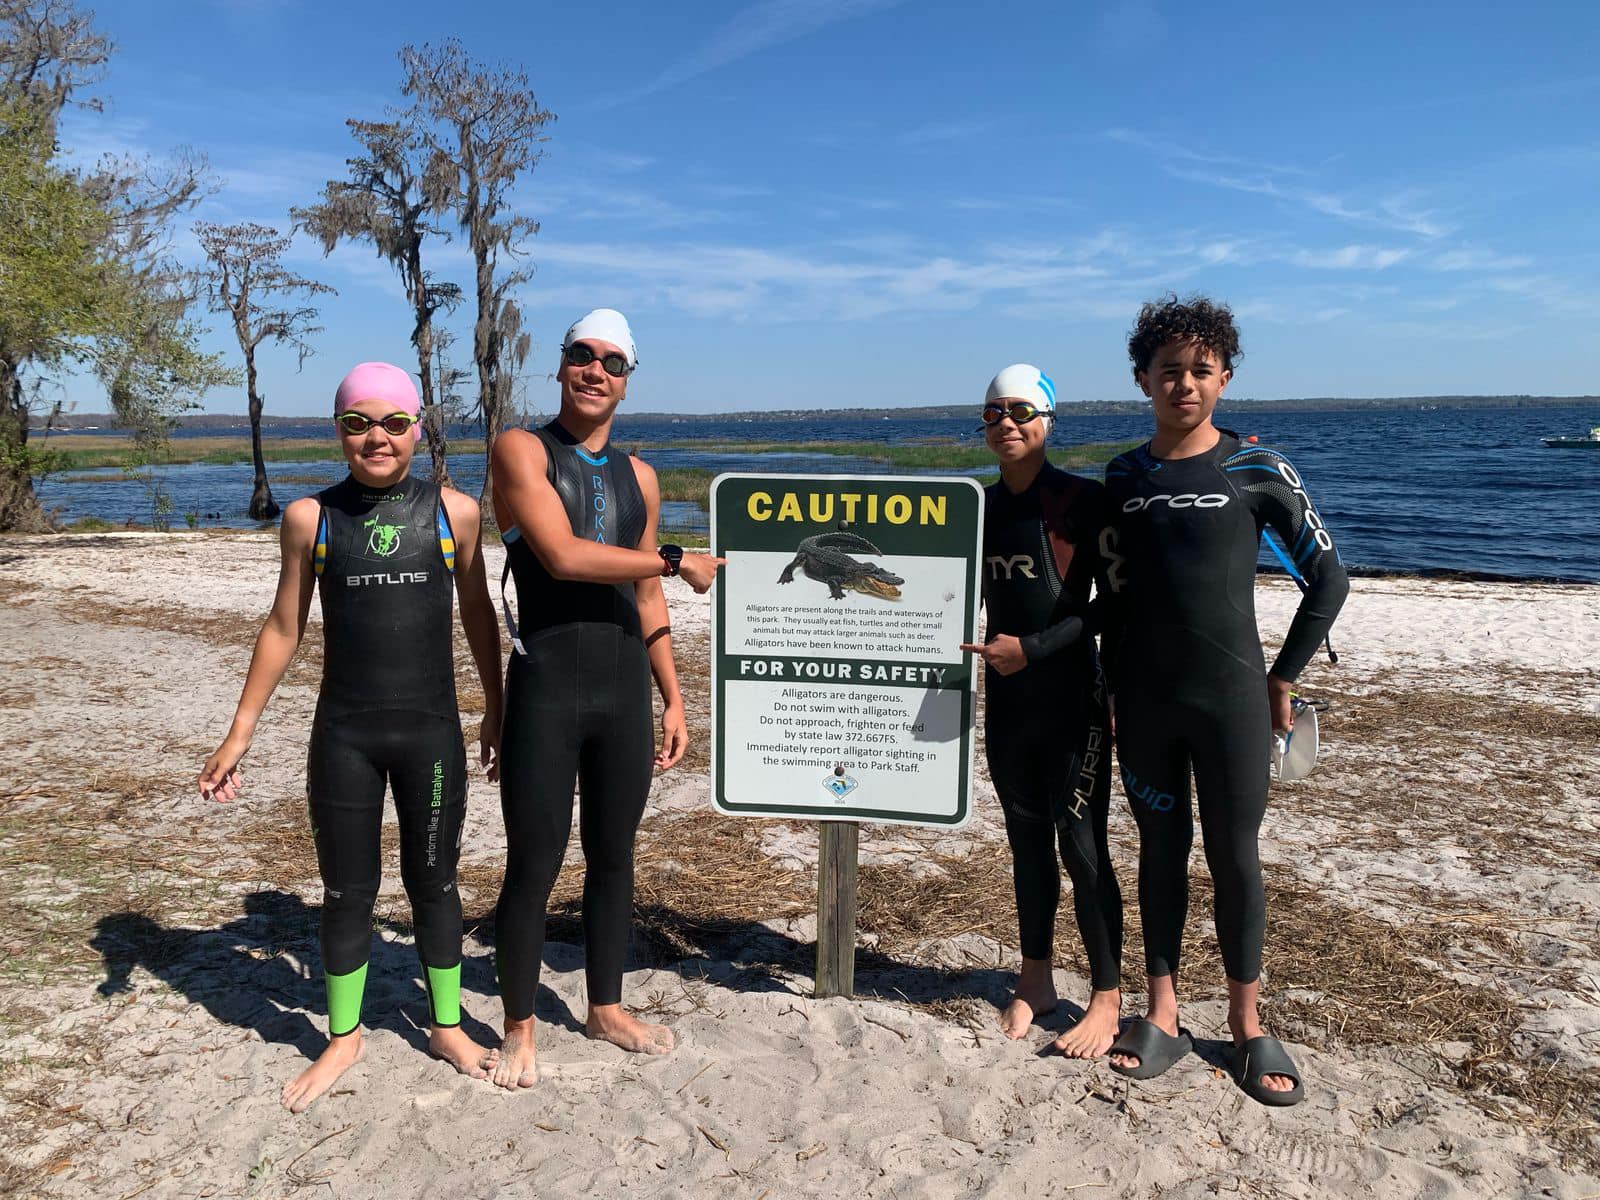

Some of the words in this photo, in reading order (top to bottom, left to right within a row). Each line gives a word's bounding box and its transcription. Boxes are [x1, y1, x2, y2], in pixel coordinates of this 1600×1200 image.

[747, 491, 947, 526] CAUTION
[1122, 493, 1230, 513] orca
[1278, 462, 1332, 550] orca
[986, 555, 1038, 579] TYR
[746, 604, 779, 613] Alligators
[823, 607, 843, 615] along
[893, 610, 933, 618] waterways
[784, 616, 801, 624] They
[803, 617, 828, 625] usually
[843, 618, 858, 627] fish,
[836, 629, 857, 638] larger
[858, 630, 887, 638] animals
[917, 632, 935, 640] deer.
[744, 638, 784, 648] Alligators
[786, 640, 807, 648] have
[809, 640, 831, 648] been
[833, 641, 863, 650] known
[865, 643, 875, 651] to
[876, 643, 904, 652] attack
[905, 644, 943, 654] humans.
[740, 660, 784, 676] FOR
[792, 661, 852, 678] YOUR
[859, 664, 946, 683] SAFETY
[781, 688, 827, 699] Alligators
[830, 691, 846, 699] are
[848, 691, 903, 703] dangerous.
[774, 702, 787, 711] Do
[790, 704, 807, 712] not
[809, 704, 835, 713] swim
[838, 705, 860, 714] with
[862, 705, 910, 717] alligators.
[760, 715, 773, 724] Do
[776, 717, 793, 726] not
[795, 718, 844, 728] approach,
[847, 719, 886, 731] frighten
[902, 722, 924, 732] feed
[784, 729, 797, 740] by
[798, 732, 823, 740] state
[825, 731, 842, 740] law
[845, 732, 898, 744] 372.667FS.
[747, 742, 807, 754] Immediately
[810, 746, 840, 755] report
[843, 746, 883, 757] alligator
[885, 749, 924, 761] sighting
[927, 752, 936, 760] in
[763, 756, 779, 765] the
[781, 757, 831, 769] swimming
[833, 760, 855, 768] area
[871, 761, 892, 770] Park
[895, 762, 920, 773] Staff.
[427, 817, 439, 832] like
[426, 833, 437, 867] Perform
